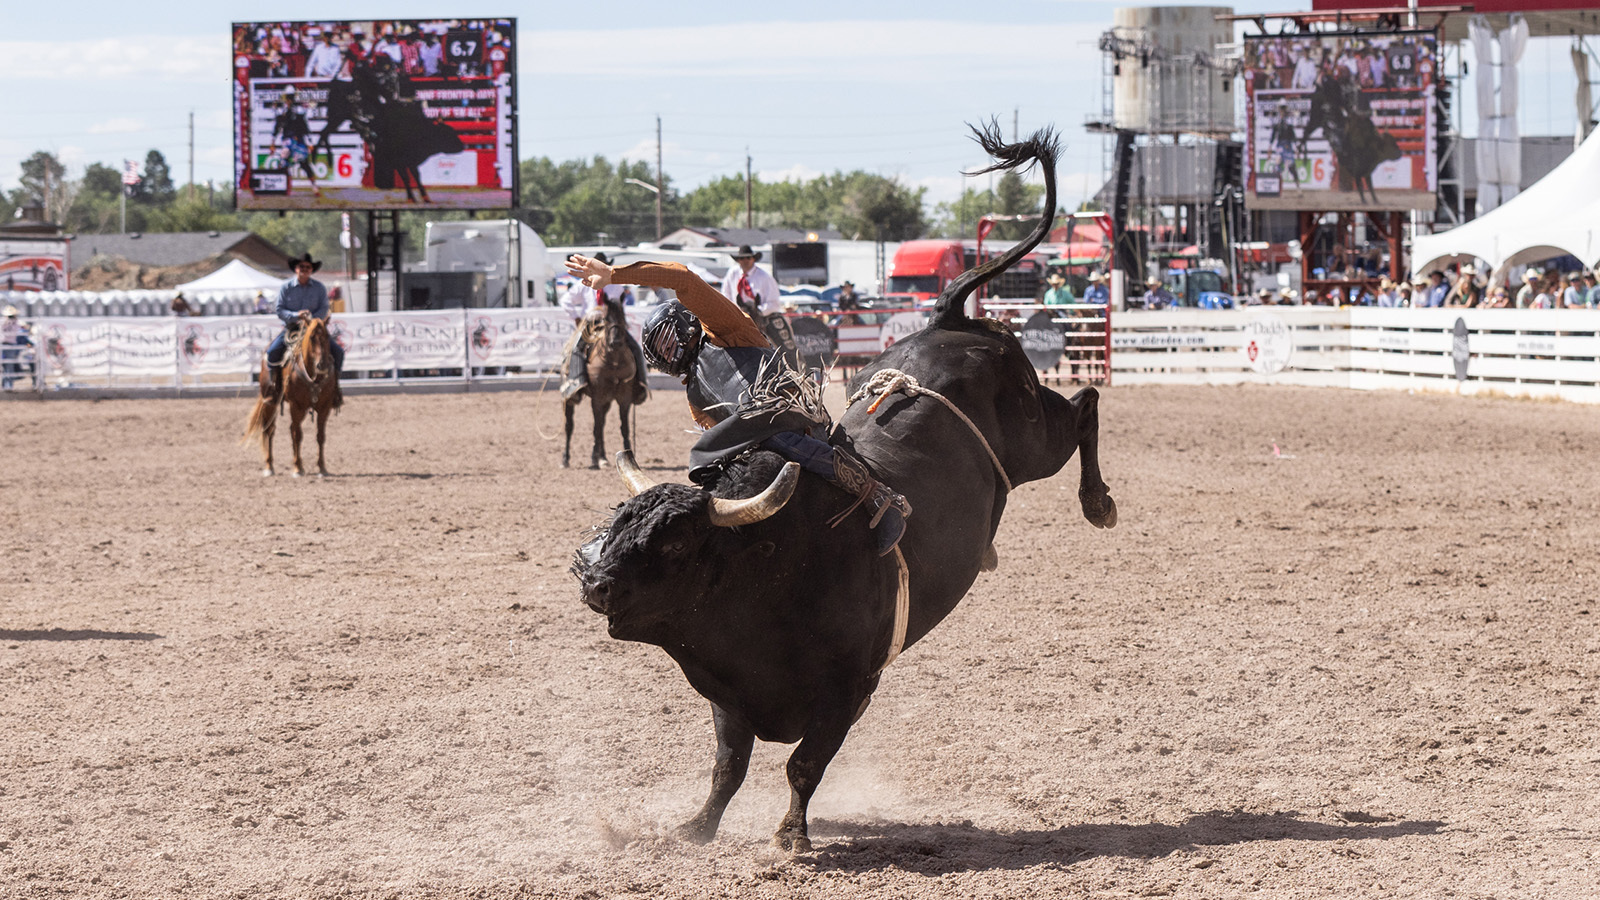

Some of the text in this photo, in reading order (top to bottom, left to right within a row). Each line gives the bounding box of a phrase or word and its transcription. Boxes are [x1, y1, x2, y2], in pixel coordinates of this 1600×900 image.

[450, 41, 477, 57] 6.7
[1391, 55, 1412, 70] 6.8
[338, 154, 352, 178] 6
[356, 322, 465, 339] CHEYENNE
